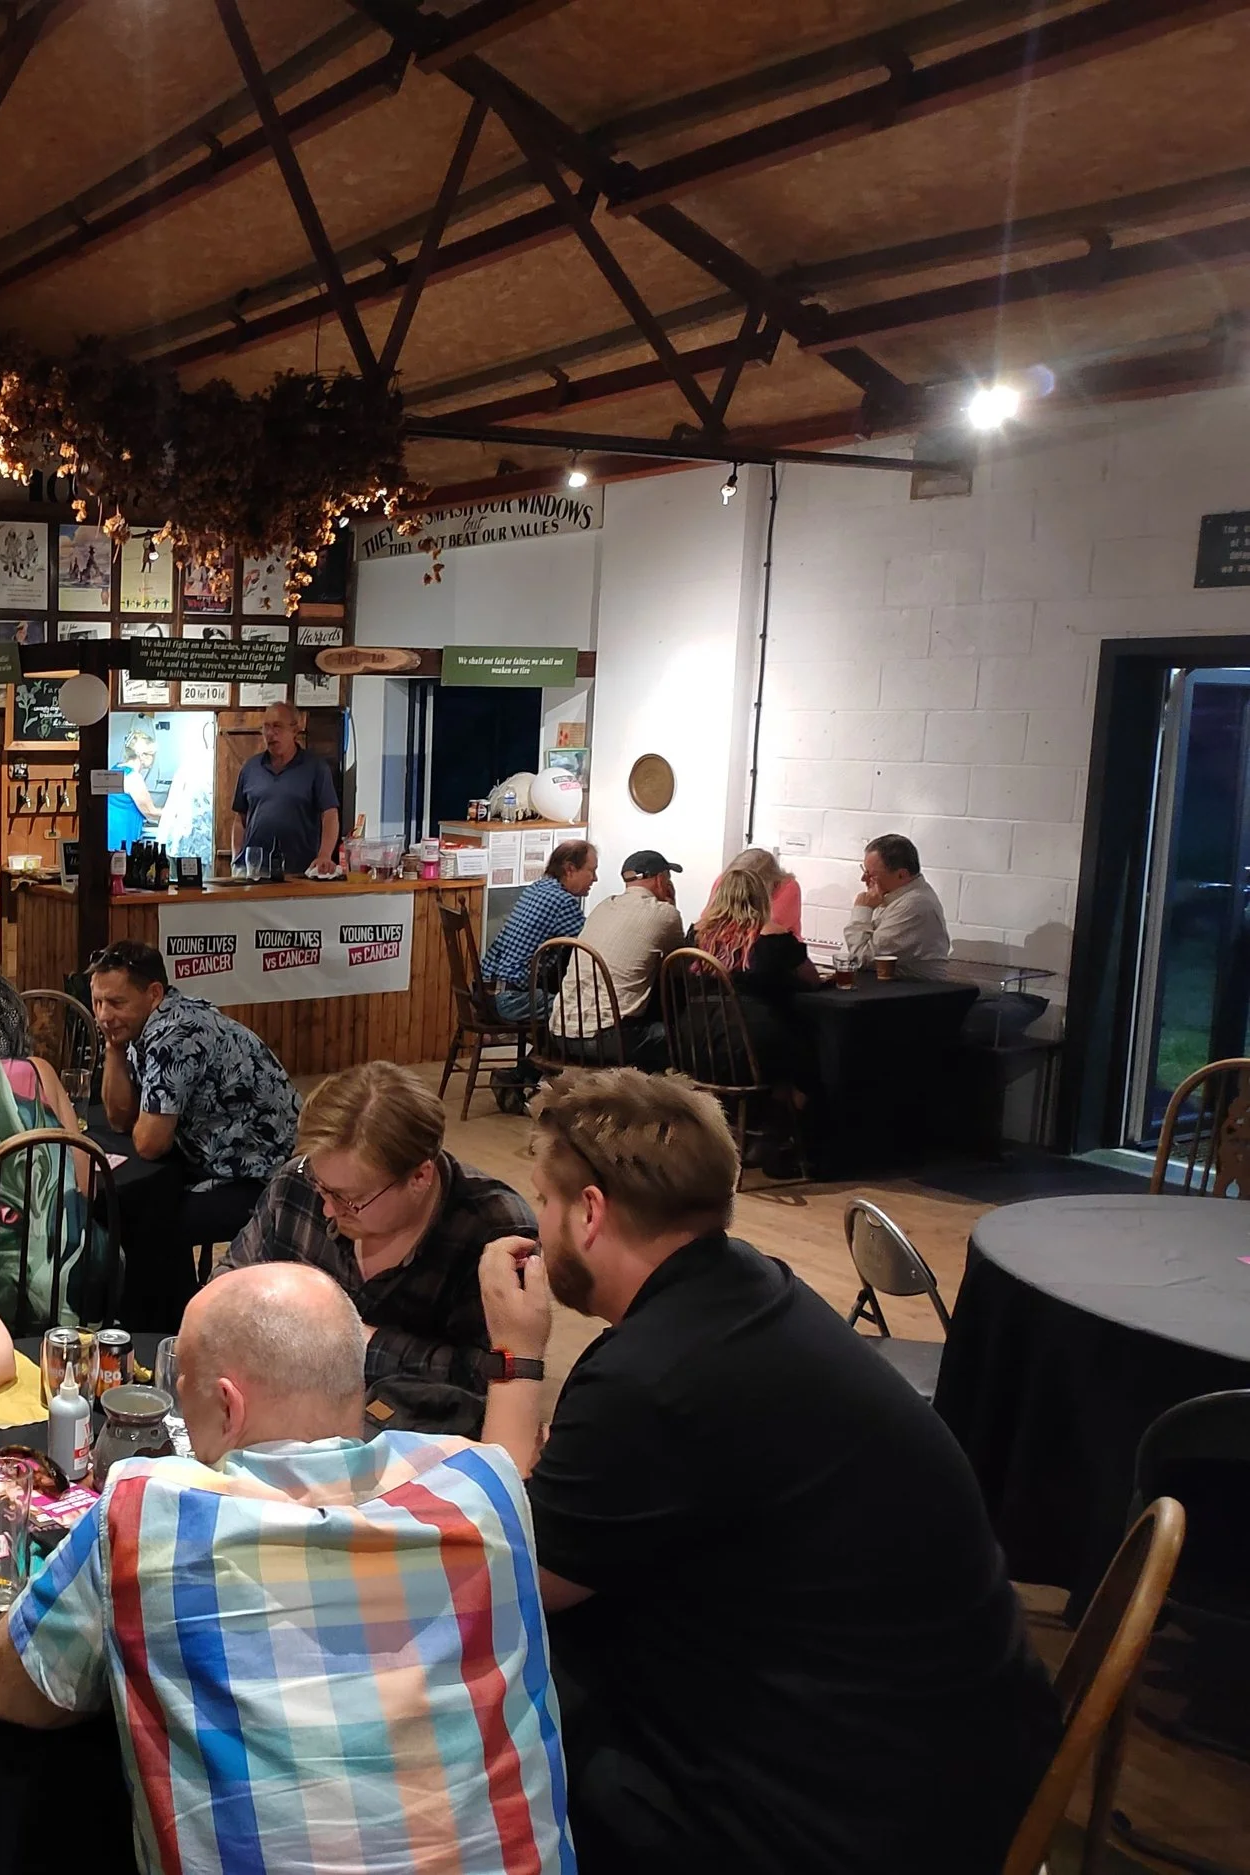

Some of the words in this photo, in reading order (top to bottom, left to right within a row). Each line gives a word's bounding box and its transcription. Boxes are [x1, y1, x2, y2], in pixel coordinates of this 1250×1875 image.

[362, 526, 394, 557] THEY
[517, 494, 593, 529] WINDOWS
[388, 543, 412, 556] THEY
[449, 531, 478, 547] BEAT
[482, 526, 507, 541] OUR
[511, 519, 559, 538] VALUES
[141, 639, 152, 647] We
[154, 640, 171, 648] shall
[172, 640, 190, 649] fight
[201, 641, 212, 649] the
[213, 641, 240, 650] beaches,
[252, 644, 269, 652] shall
[270, 644, 287, 653] fight
[150, 649, 161, 657] the
[163, 649, 189, 659] landing
[230, 652, 248, 660] shall
[248, 653, 265, 662] fight
[266, 653, 274, 661] in
[274, 654, 286, 662] the
[468, 657, 483, 665] shall
[146, 658, 165, 667] fields
[166, 660, 180, 668] and
[181, 660, 189, 668] in
[190, 660, 200, 668] the
[238, 662, 255, 670] shall
[255, 663, 272, 672] fight
[273, 663, 281, 672] in
[156, 669, 168, 677] the
[199, 670, 216, 678] shall
[235, 671, 268, 680] surrender
[185, 688, 196, 698] 20
[258, 932, 292, 947] YOUNG
[294, 932, 320, 947] LIVES
[342, 927, 374, 942] YOUNG
[376, 926, 401, 941] LIVES
[170, 938, 204, 954] YOUNG
[206, 937, 234, 953] LIVES
[351, 952, 362, 963] vs
[364, 942, 398, 961] CANCER
[177, 965, 190, 976] vs
[192, 955, 231, 975] CANCER
[265, 958, 276, 969] vs
[278, 949, 318, 968] CANCER
